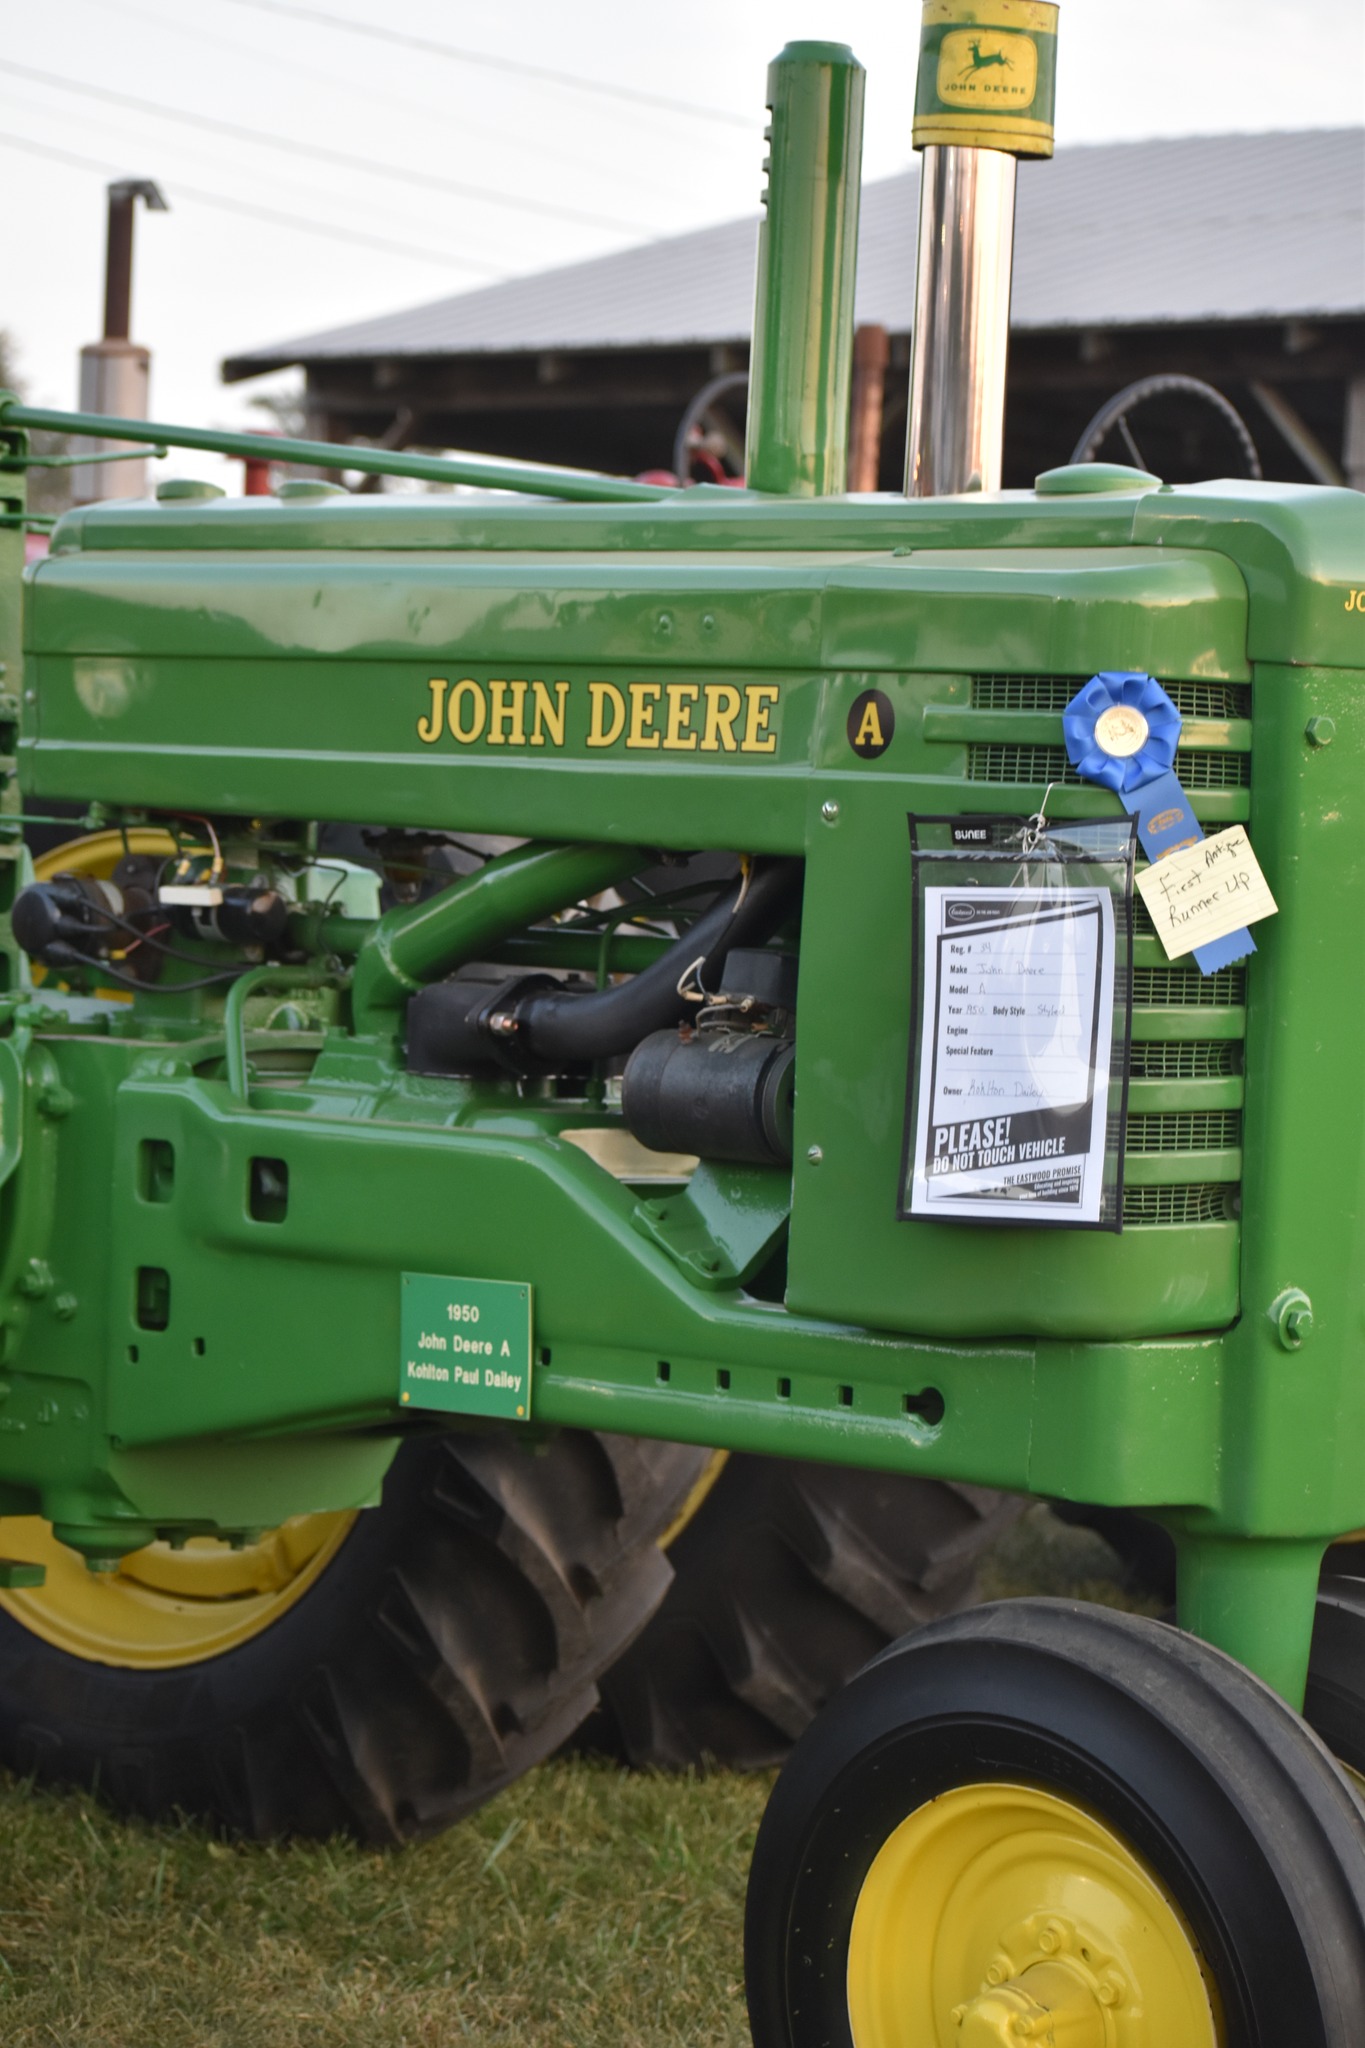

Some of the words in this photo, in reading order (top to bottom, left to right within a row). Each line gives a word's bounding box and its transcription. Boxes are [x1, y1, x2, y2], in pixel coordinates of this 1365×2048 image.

[945, 83, 976, 92] JOHN
[984, 85, 1027, 94] DEERE
[416, 678, 570, 747] JOHN
[585, 681, 780, 754] DEERE
[855, 701, 885, 746] A
[954, 829, 987, 840] SUNEE
[1160, 869, 1202, 903] First
[1168, 891, 1220, 928] Runner
[950, 944, 965, 955] Reg.
[967, 945, 972, 953] #
[949, 964, 968, 974] Make
[949, 985, 969, 994] Model
[948, 1005, 963, 1015] Year
[992, 1006, 1008, 1017] Body
[1009, 1006, 1026, 1017] Style
[947, 1025, 968, 1037] Engine
[946, 1046, 969, 1057] Special
[970, 1046, 994, 1056] Feature
[943, 1086, 963, 1096] Owner
[934, 1116, 1012, 1157] PLEASE!
[932, 1156, 950, 1175] DO
[952, 1150, 975, 1172] NOT
[977, 1144, 1016, 1168] TOUCH
[1019, 1136, 1066, 1161] VEHICLE
[1003, 1175, 1015, 1186] THE
[1016, 1170, 1051, 1184] EASTWOOD
[1052, 1165, 1081, 1178] PROMISE
[446, 1304, 480, 1323] 1950
[417, 1331, 447, 1351] John
[453, 1335, 493, 1356] Deere
[500, 1339, 511, 1357] A
[407, 1361, 449, 1382] Kohlton
[454, 1366, 480, 1385] Paul
[485, 1369, 522, 1393] Dailey
